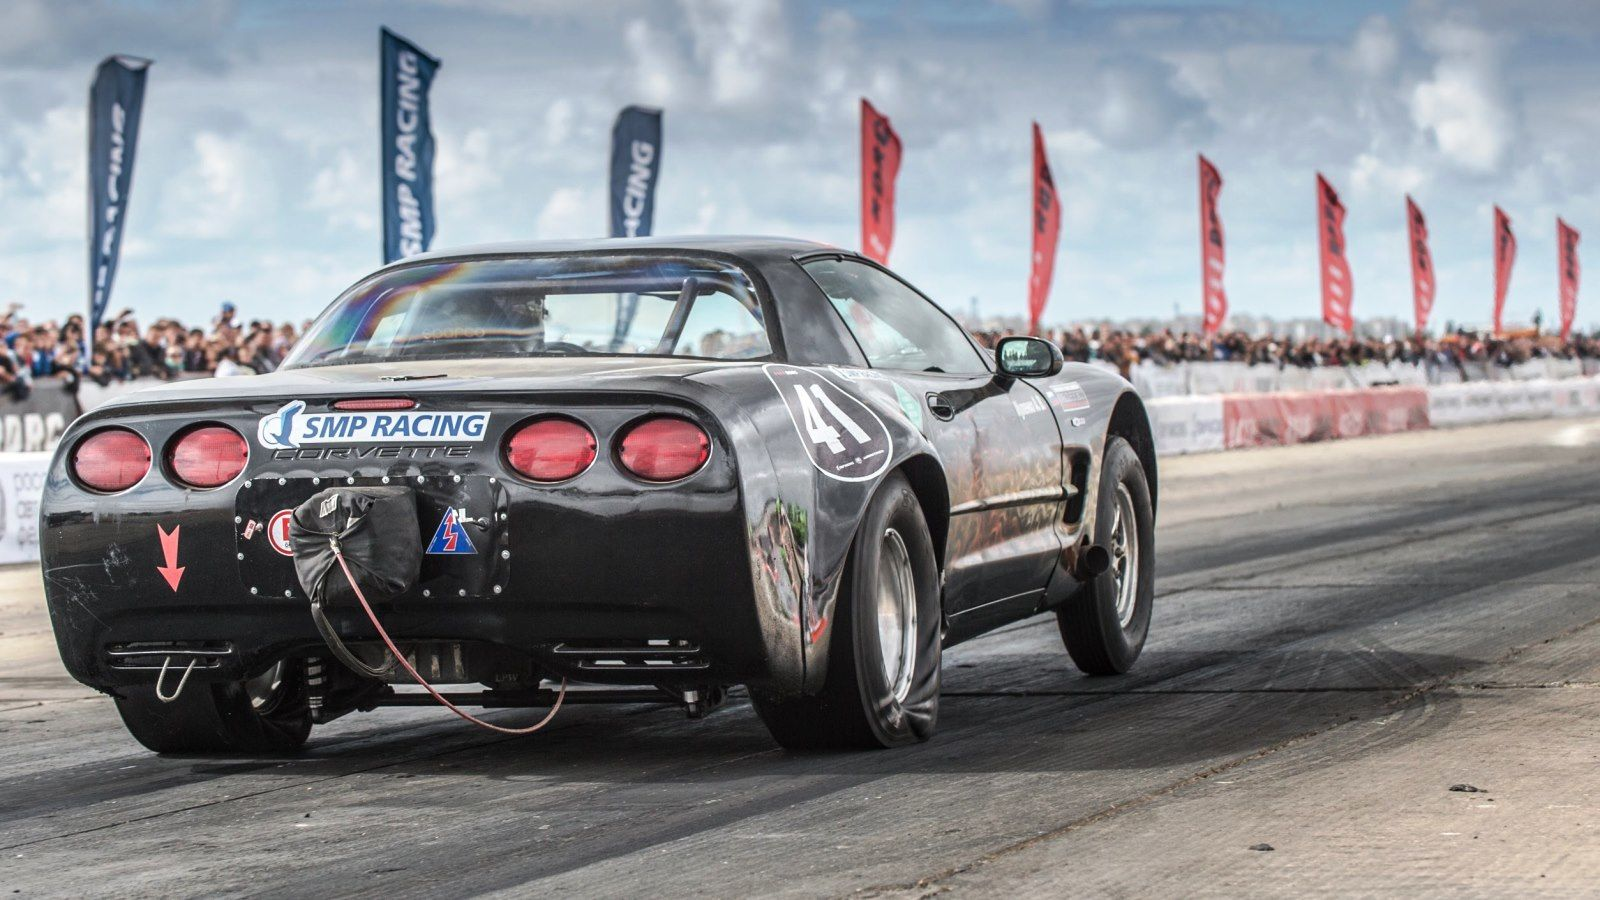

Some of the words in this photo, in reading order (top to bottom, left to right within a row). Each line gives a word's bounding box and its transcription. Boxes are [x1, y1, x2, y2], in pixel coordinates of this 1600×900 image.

[395, 51, 421, 181] RACING
[396, 184, 423, 257] SMP
[271, 445, 473, 461] CORVETTE
[302, 415, 370, 438] SMP
[371, 414, 485, 438] RACING
[793, 384, 872, 454] 41
